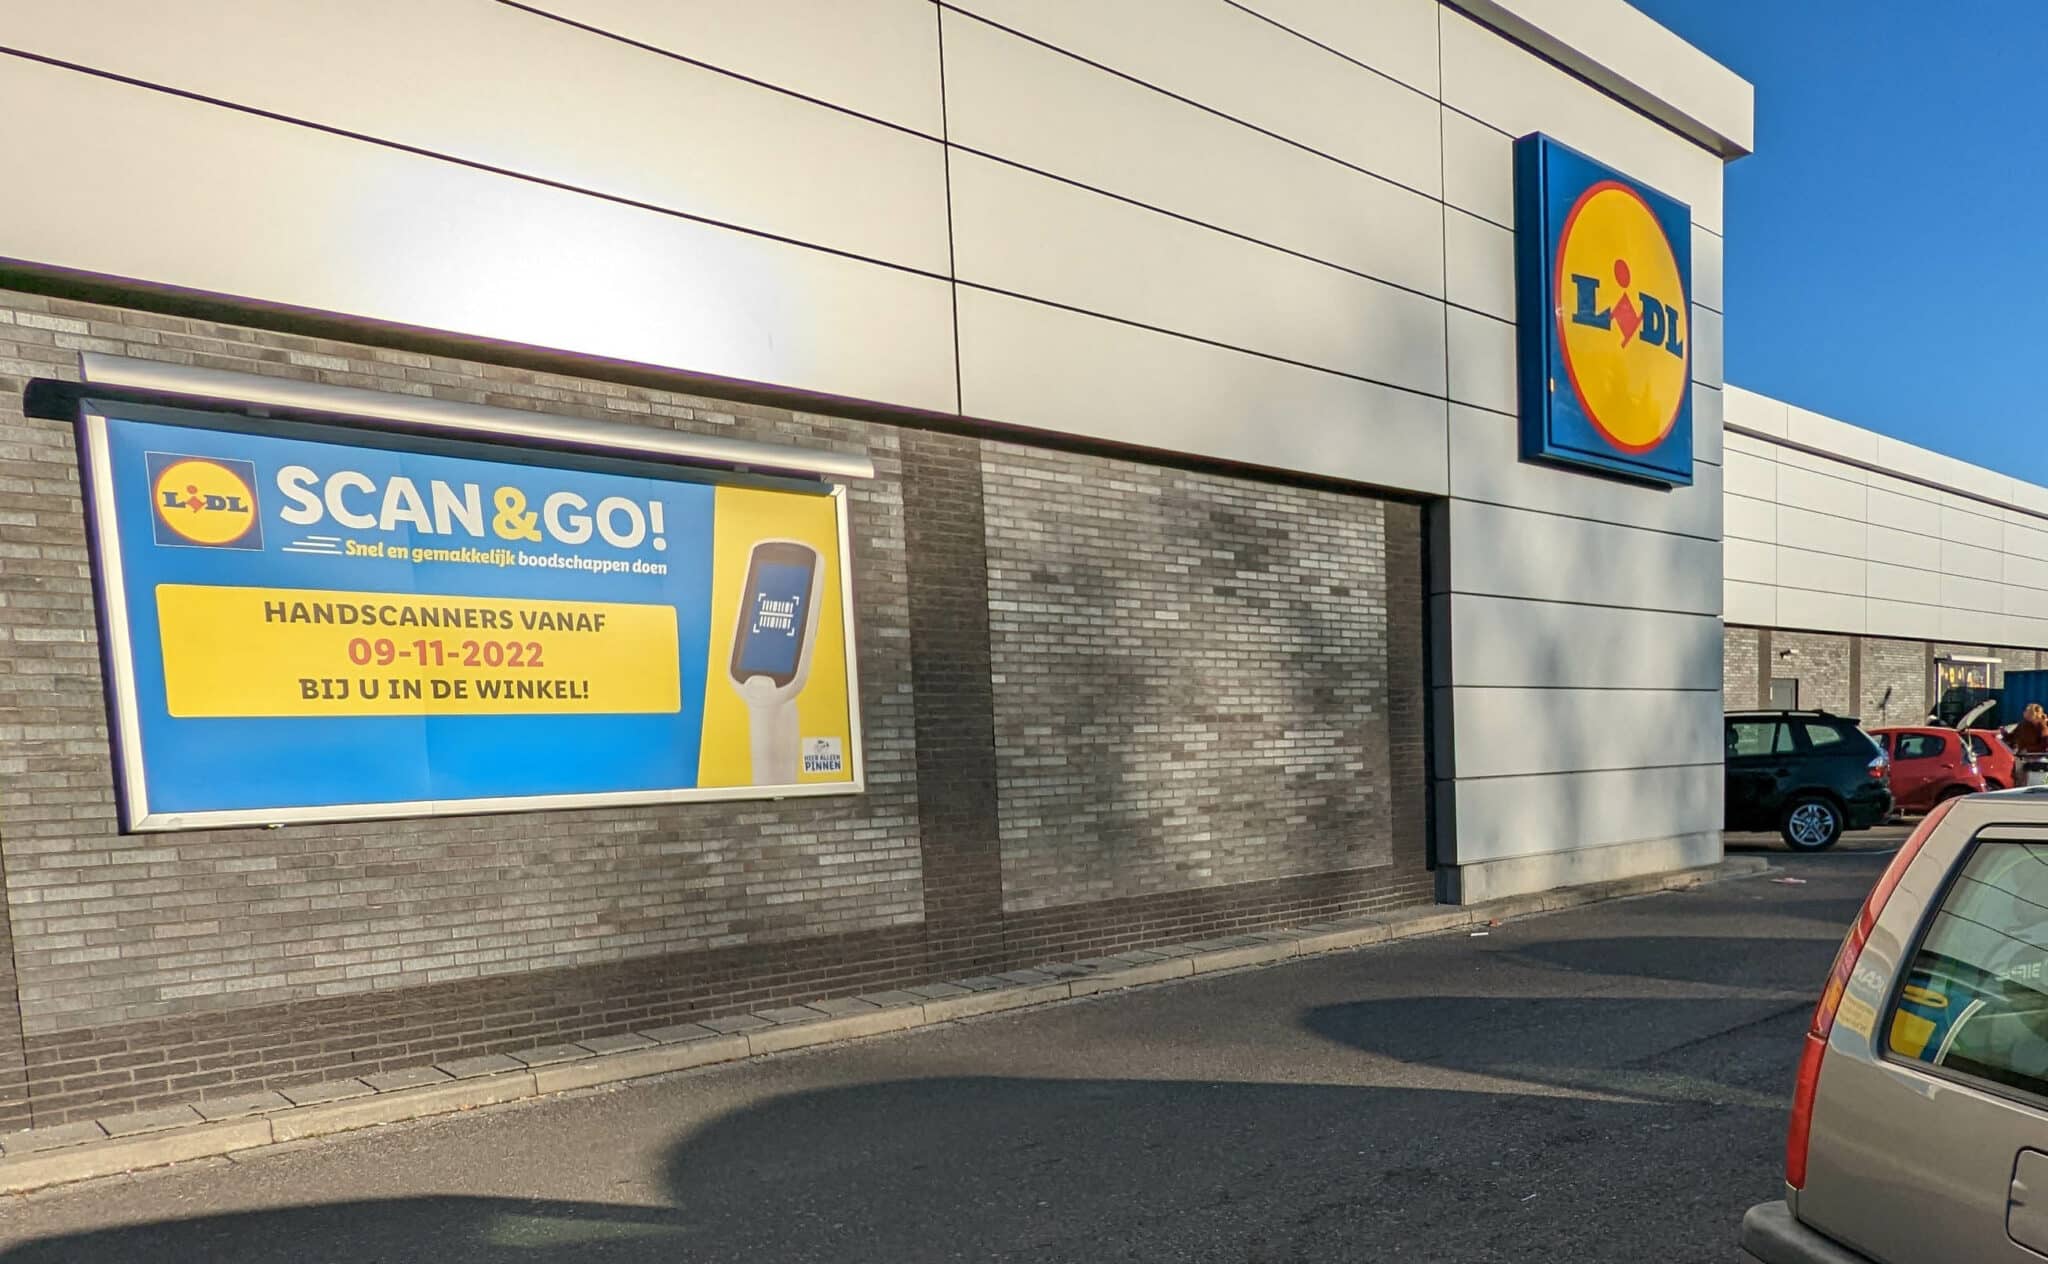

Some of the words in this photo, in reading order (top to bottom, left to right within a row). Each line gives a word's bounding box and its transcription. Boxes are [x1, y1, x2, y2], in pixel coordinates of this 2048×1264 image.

[276, 465, 667, 552] SCAN&GO!
[345, 540, 384, 557] Snel
[387, 546, 409, 559] en
[411, 547, 515, 568] gemakkelijk
[518, 551, 629, 574] boodschappen
[632, 559, 668, 575] doen
[264, 601, 514, 630] HANDSCANNERS
[519, 610, 606, 632] VANAF
[348, 637, 544, 668] 09-11-2022
[298, 678, 350, 700] BIJ
[359, 679, 379, 700] U
[388, 679, 422, 700] IN
[430, 679, 468, 700] DE
[475, 679, 589, 700] WINKEL!
[804, 760, 842, 771] PINNEN
